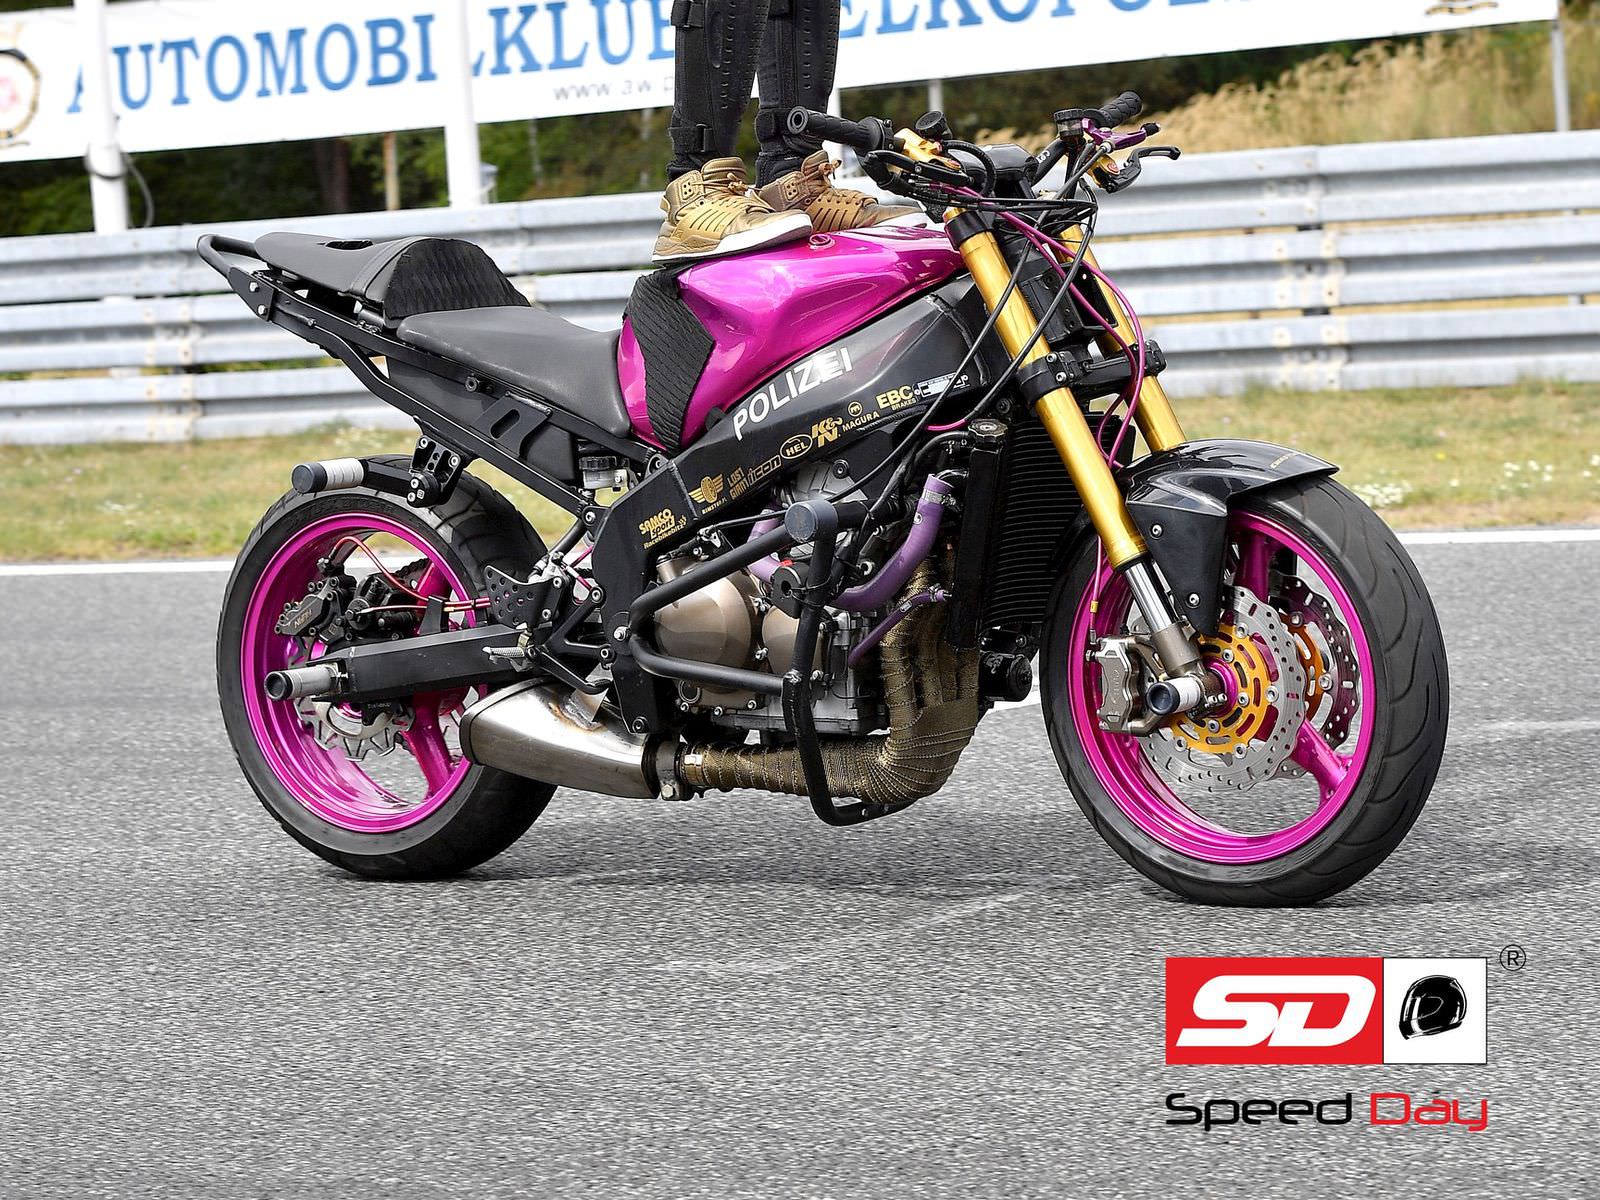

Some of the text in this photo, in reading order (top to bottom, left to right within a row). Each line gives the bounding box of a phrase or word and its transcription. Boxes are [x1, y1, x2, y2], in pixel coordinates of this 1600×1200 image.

[733, 346, 853, 441] POLIZEI
[876, 385, 914, 409] EBC
[891, 398, 917, 411] BRAKES
[842, 411, 880, 432] MAGURA
[785, 440, 809, 457] HEL
[639, 508, 672, 535] SAMCO
